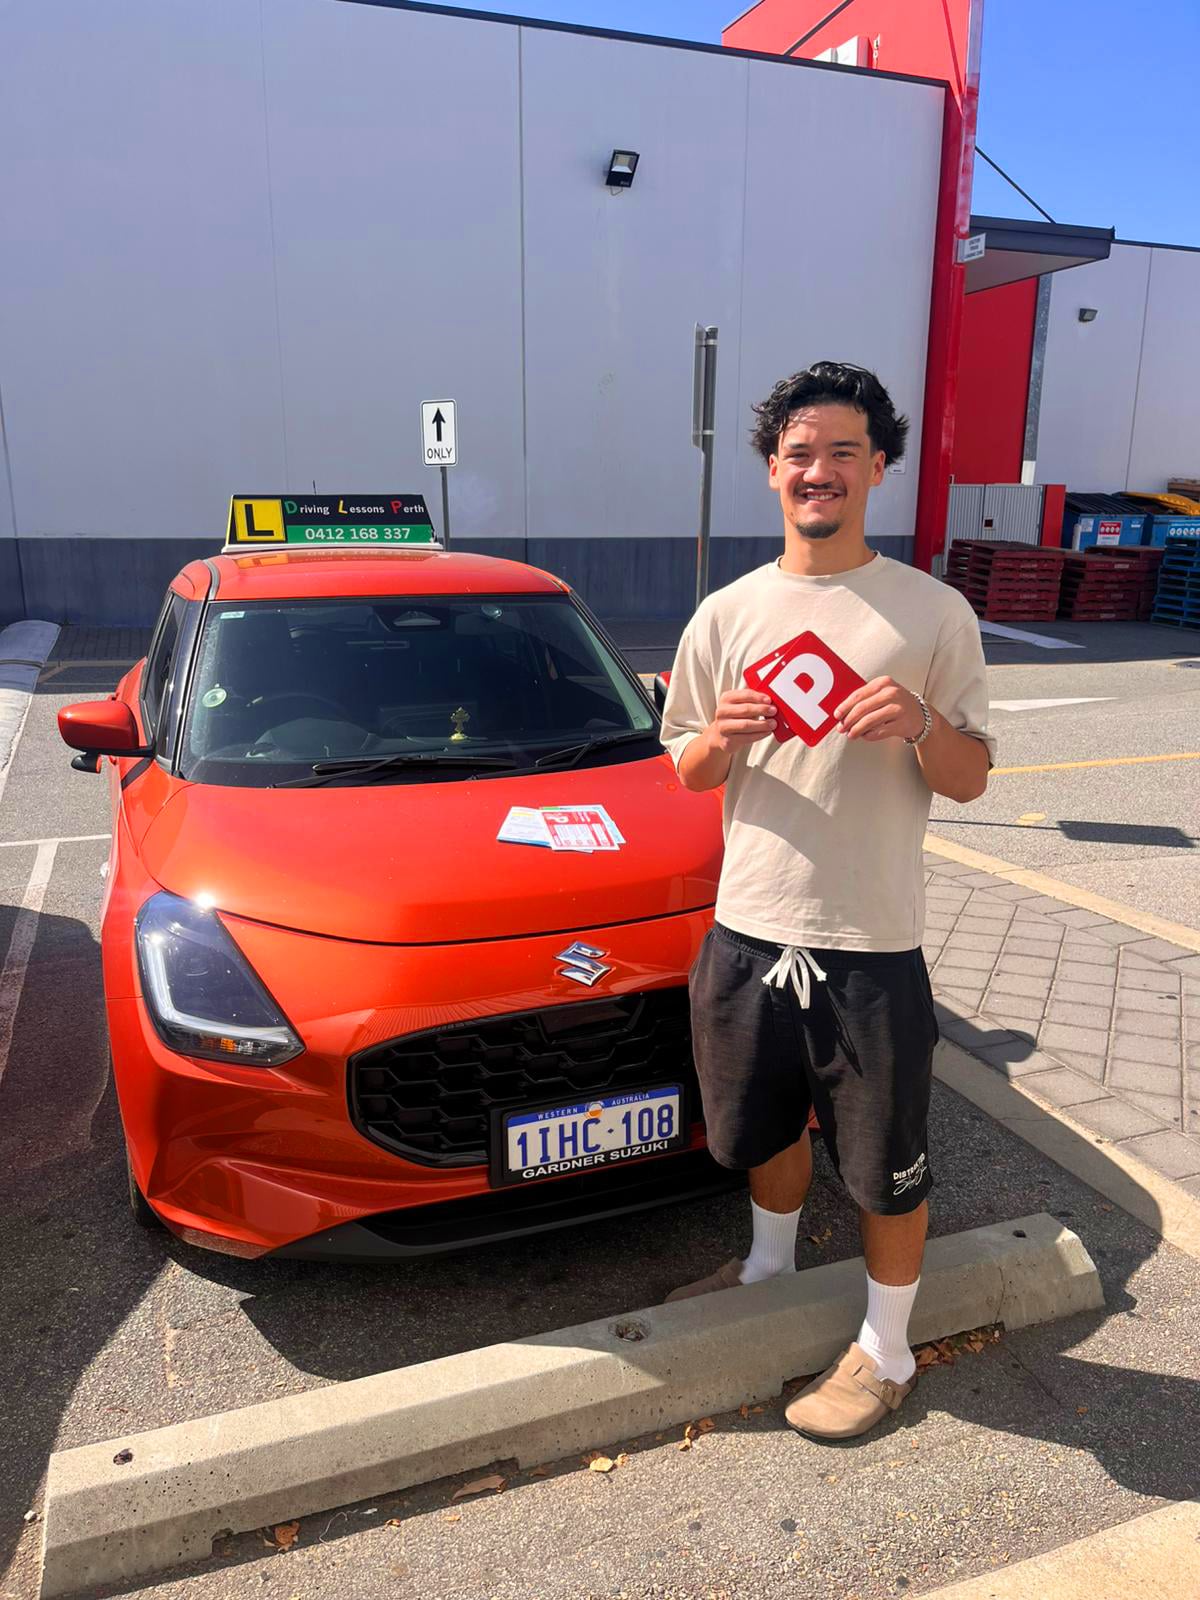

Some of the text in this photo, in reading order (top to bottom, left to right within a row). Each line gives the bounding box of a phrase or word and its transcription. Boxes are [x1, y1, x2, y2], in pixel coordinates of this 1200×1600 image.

[426, 447, 453, 460] ONLY
[244, 503, 275, 537] L
[284, 499, 425, 515] Driving Lessons Perth
[305, 527, 411, 541] 0412 168 337
[768, 653, 834, 731] P
[537, 1093, 650, 1120] WESTERN AUSTRALIA
[522, 1140, 668, 1179] GARDNER SUZUKI
